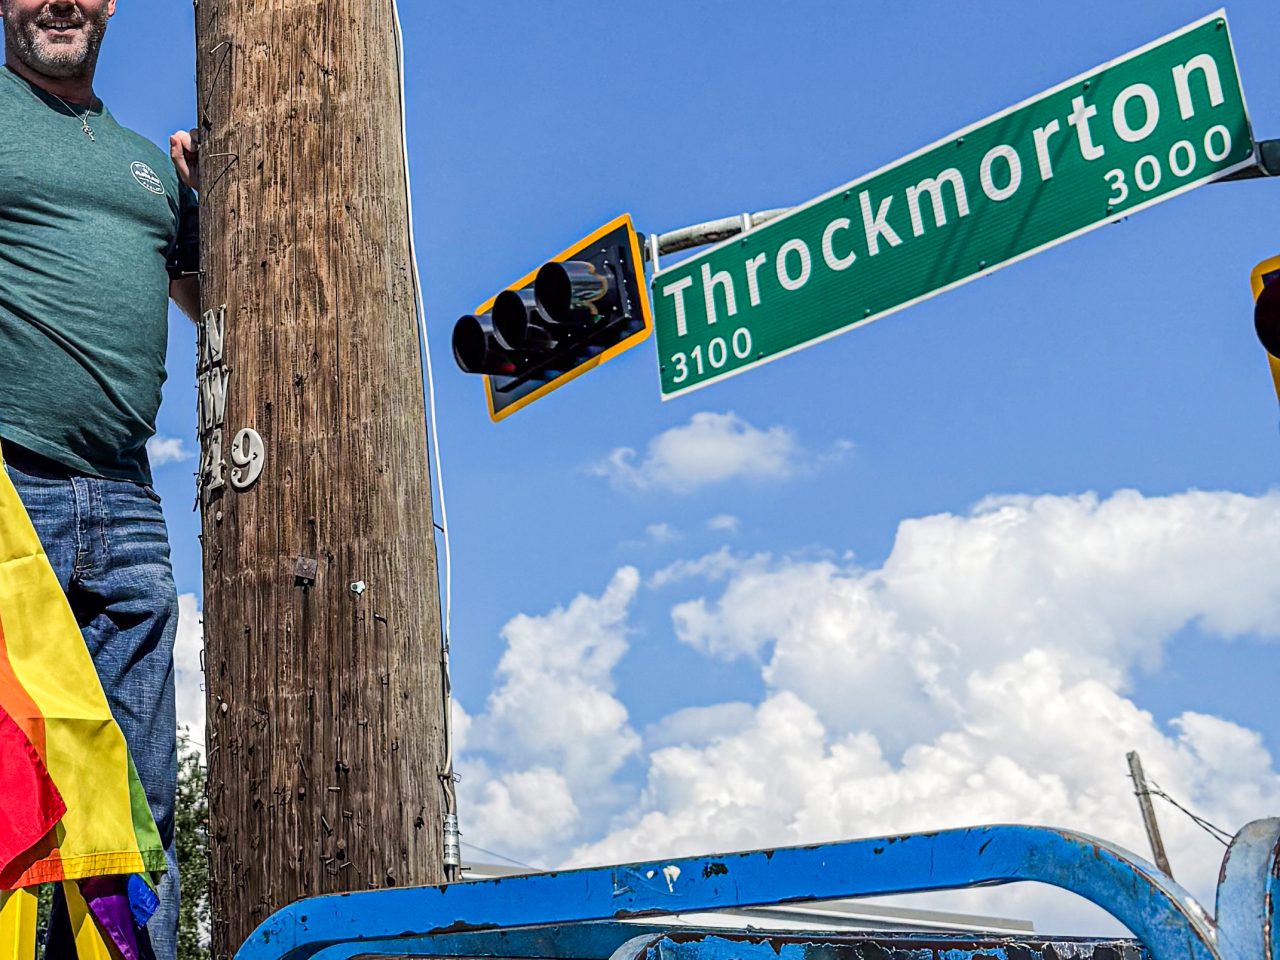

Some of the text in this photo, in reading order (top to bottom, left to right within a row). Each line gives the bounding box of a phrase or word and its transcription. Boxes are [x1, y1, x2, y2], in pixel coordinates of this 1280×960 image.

[662, 53, 1224, 337] Throckmorton
[1103, 124, 1232, 205] 3000
[670, 327, 753, 383] 3100
